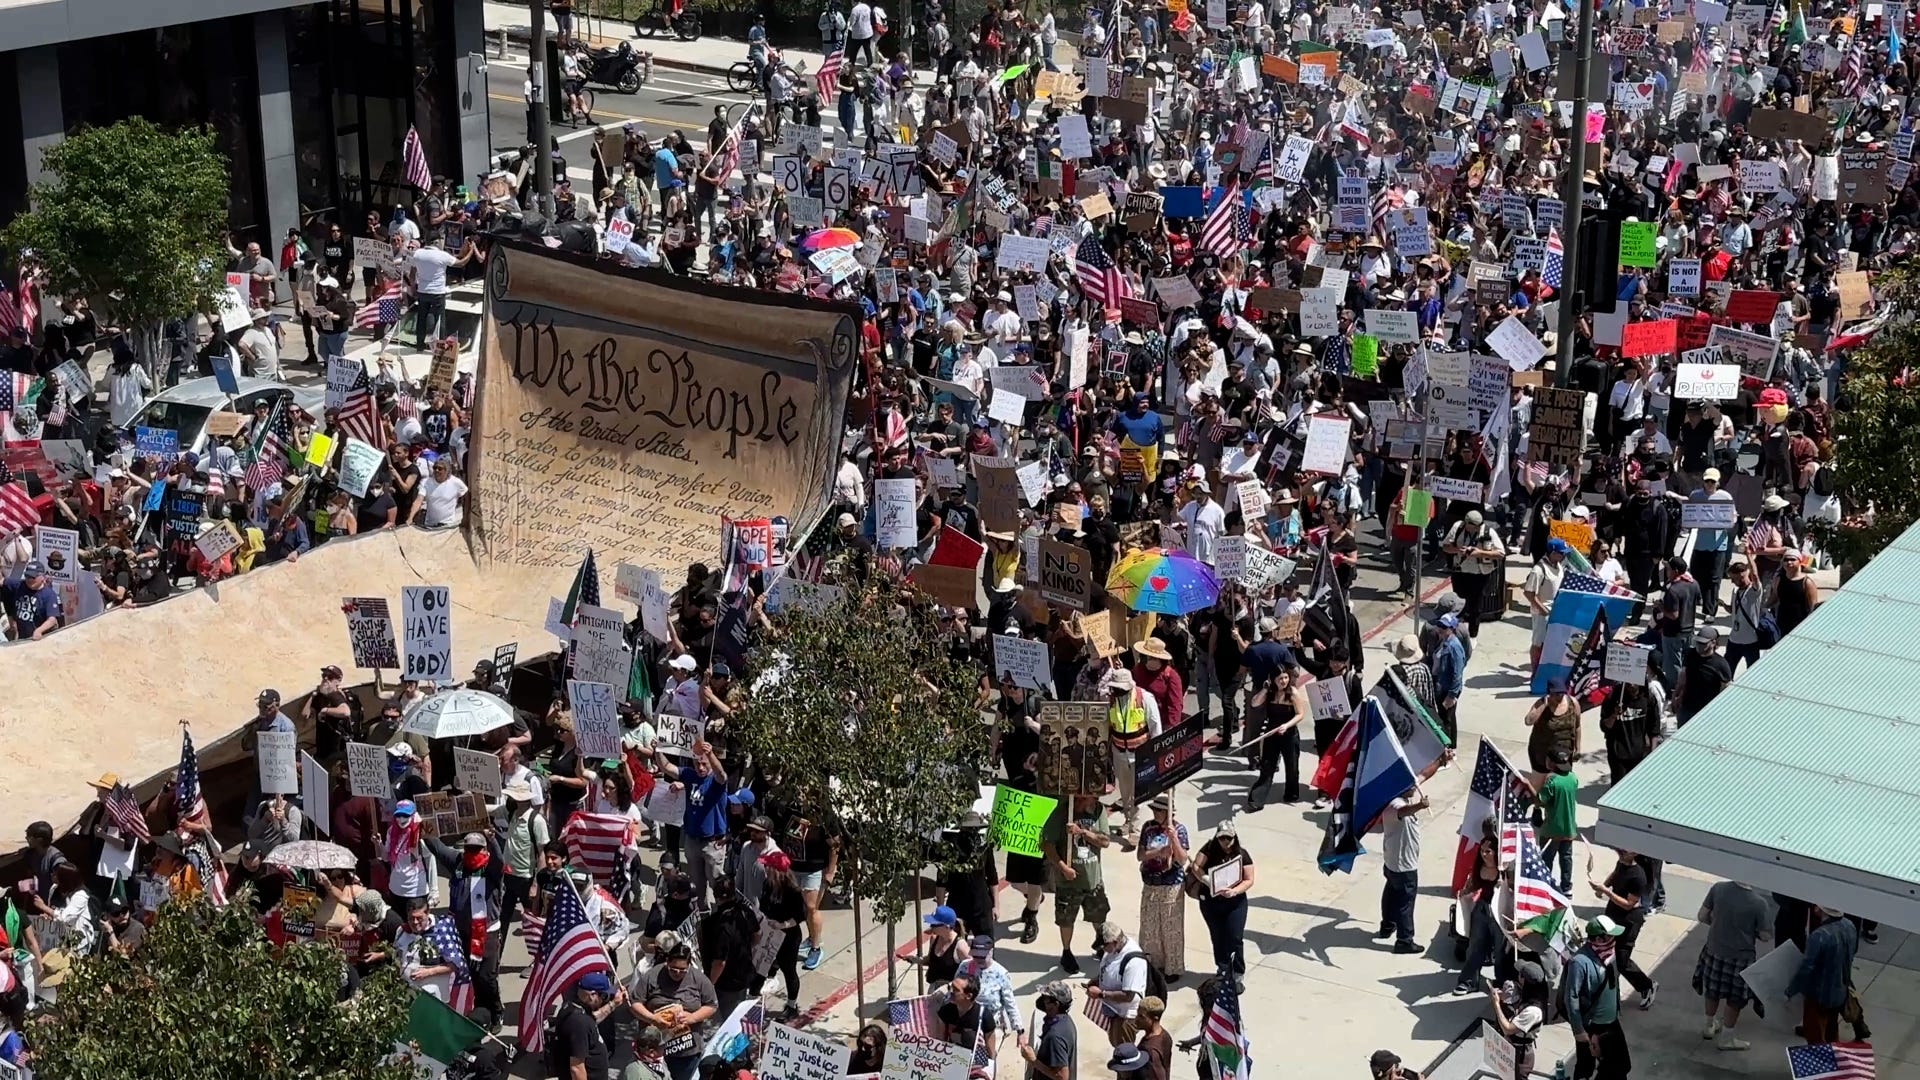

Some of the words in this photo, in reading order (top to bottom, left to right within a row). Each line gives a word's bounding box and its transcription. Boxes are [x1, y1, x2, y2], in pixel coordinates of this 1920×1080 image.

[1286, 138, 1310, 152] CHINGA
[785, 160, 798, 192] 8
[896, 160, 915, 191] 7
[1278, 165, 1301, 181] MIGRA
[1741, 168, 1773, 178] Silence
[829, 173, 845, 203] 6
[872, 166, 886, 196] 4
[1126, 195, 1157, 210] CHINGA
[612, 220, 632, 235] NO
[1398, 235, 1426, 243] CONVICT
[1400, 243, 1426, 251] REMOVE
[1664, 304, 1693, 314] PROTESTING
[500, 304, 581, 397] We
[583, 338, 645, 414] the
[644, 349, 799, 459] People
[1677, 382, 1736, 396] RESIST
[1446, 398, 1467, 407] Metro
[1534, 390, 1551, 405] THE
[1554, 391, 1584, 409] MOST
[1430, 407, 1436, 415] 4
[1535, 407, 1577, 428] SAVAGE
[520, 408, 552, 430] of
[542, 411, 575, 432] the
[579, 416, 640, 446] United
[1430, 416, 1440, 424] 90
[137, 434, 174, 446] FAMILIES
[135, 449, 176, 461] TOGETHER
[516, 436, 558, 457] order
[561, 445, 579, 461] to
[575, 449, 617, 470] form
[620, 462, 631, 473] a
[628, 464, 660, 481] more
[655, 473, 726, 496] perfect
[728, 480, 774, 509] Union,
[487, 449, 553, 474] establish
[615, 481, 670, 503] insure
[674, 493, 735, 518] domestic
[531, 480, 554, 494] for
[171, 502, 201, 513] LIBERT
[170, 520, 200, 531] JUSTIC
[42, 532, 71, 540] REMEMBER
[1220, 538, 1239, 546] STOP
[1218, 546, 1241, 554] MAKING
[1220, 562, 1240, 570] GREAT
[1249, 556, 1267, 573] NOT
[1263, 553, 1282, 568] ARE
[45, 571, 70, 579] ASCISM
[1221, 568, 1240, 577] AGAIN
[1042, 571, 1085, 595] KINGS
[406, 589, 448, 612] YOU
[349, 619, 387, 631] STAYING
[406, 615, 447, 640] HAVE
[355, 630, 384, 641] SILENT
[417, 639, 434, 648] THE
[408, 649, 450, 675] BODY
[574, 683, 602, 703] ICE
[1322, 693, 1334, 703] NO
[575, 703, 611, 721] MELTS
[578, 720, 610, 734] UNDER
[671, 733, 692, 748] USA
[1153, 743, 1160, 752] IF
[1161, 736, 1175, 748] YOU
[1176, 728, 1187, 739] FLY
[350, 746, 380, 759] ANNE
[350, 759, 385, 770] FRANK
[456, 753, 488, 767] NORMAL
[352, 770, 382, 779] WROTE
[1137, 765, 1156, 778] TRUMP
[353, 776, 385, 785] ABOUT
[358, 785, 386, 797] THIS!
[1004, 789, 1033, 808] ICE
[996, 800, 1008, 814] IS
[1013, 807, 1025, 821] A
[665, 1038, 694, 1056] NOW!!!
[812, 1040, 837, 1057] Never
[893, 1028, 953, 1056] Respect
[767, 1042, 790, 1058] Find
[798, 1050, 839, 1074] Justice
[773, 1056, 786, 1069] In
[793, 1062, 800, 1072] a
[898, 1053, 909, 1062] or
[914, 1058, 942, 1073] expect
